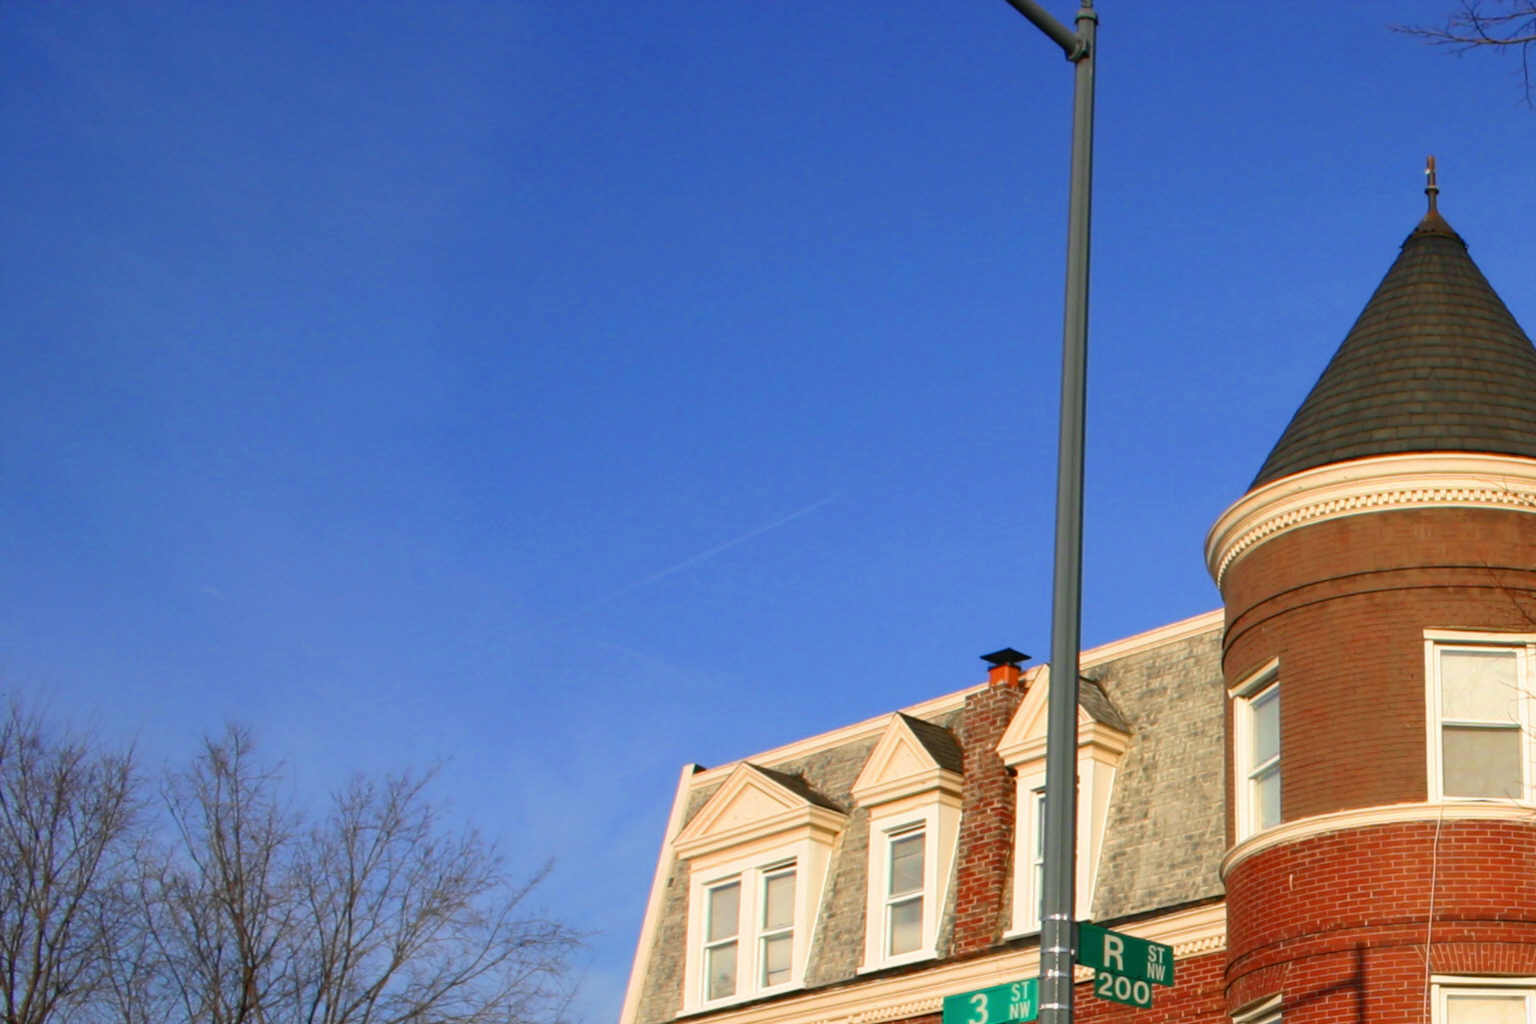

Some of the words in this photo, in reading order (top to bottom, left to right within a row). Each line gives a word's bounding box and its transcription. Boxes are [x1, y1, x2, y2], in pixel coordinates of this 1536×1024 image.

[1103, 934, 1124, 971] R
[1147, 945, 1165, 964] ST
[1147, 962, 1166, 982] NW
[1010, 981, 1030, 1002] ST
[1098, 972, 1150, 1005] 200
[1009, 1001, 1031, 1020] NW
